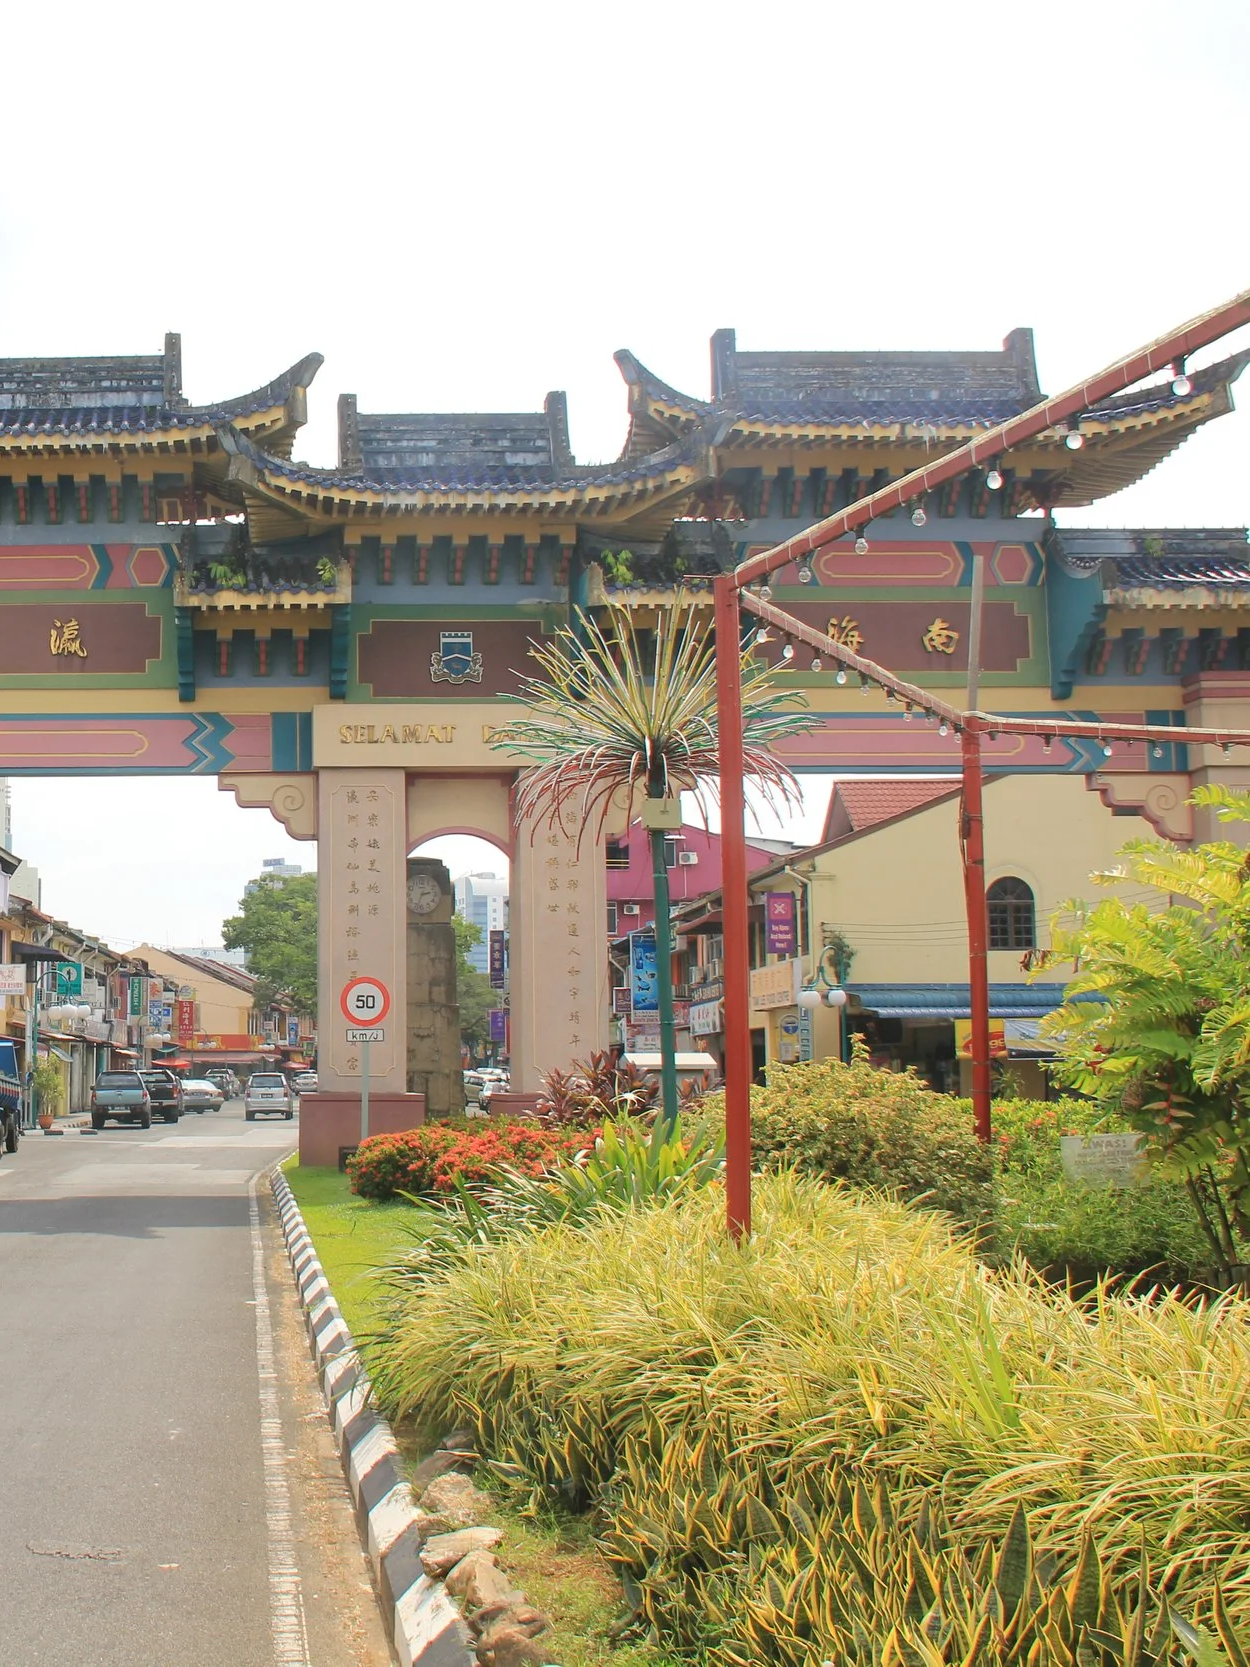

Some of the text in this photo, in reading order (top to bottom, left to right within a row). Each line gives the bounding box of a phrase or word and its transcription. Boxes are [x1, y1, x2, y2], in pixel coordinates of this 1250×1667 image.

[339, 724, 457, 744] SELAMAT
[355, 995, 376, 1009] 50
[351, 1031, 379, 1041] km/j
